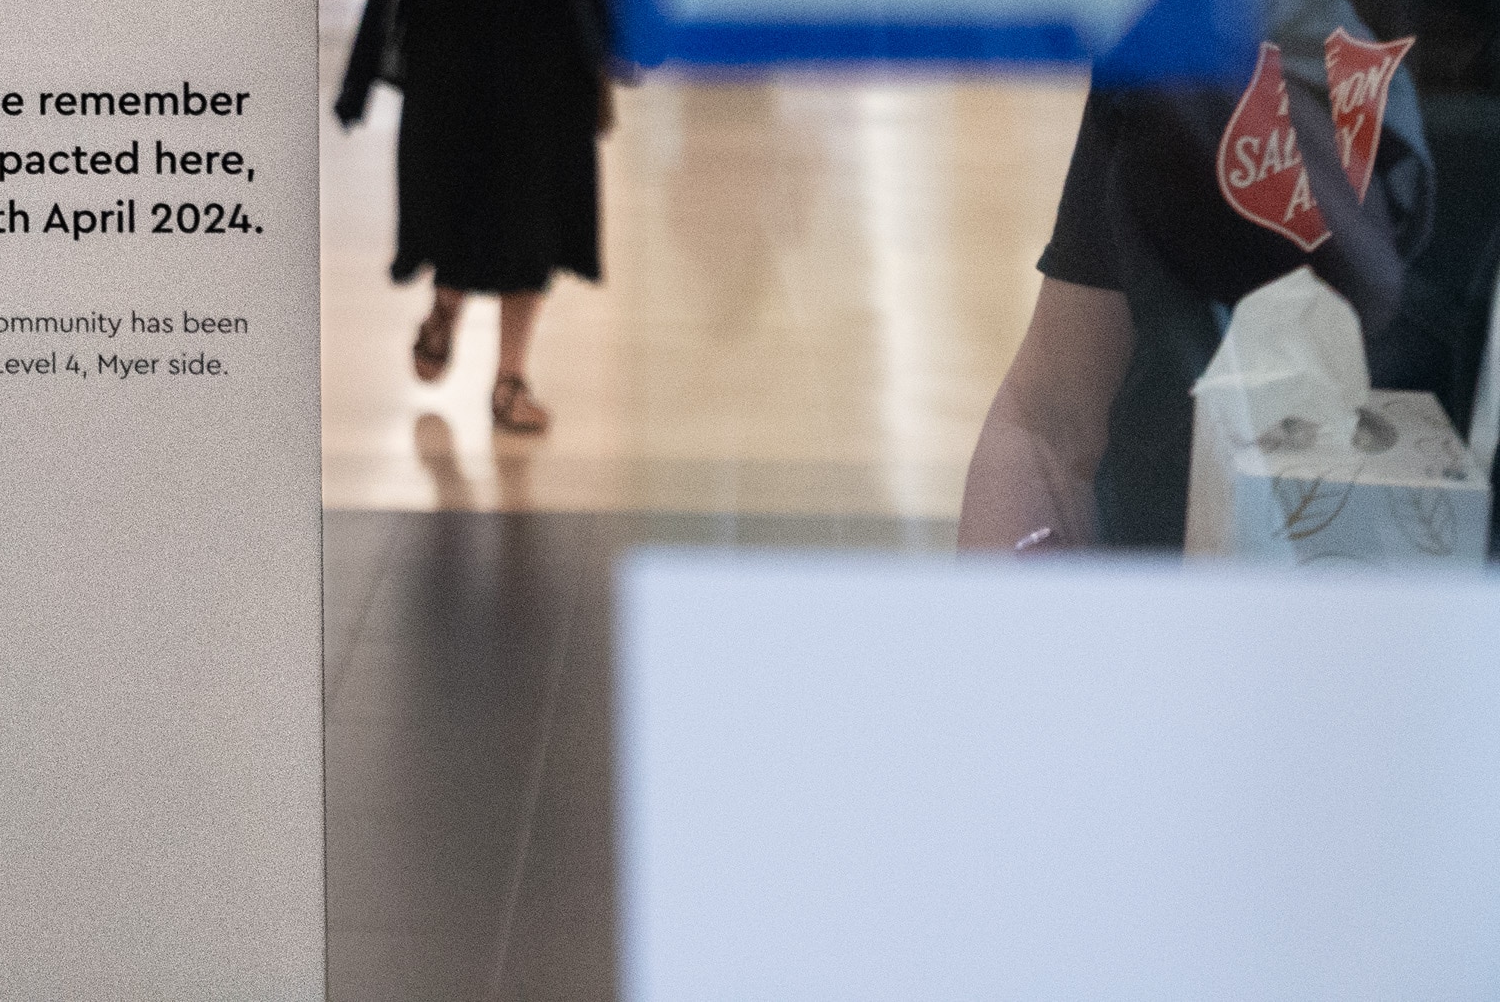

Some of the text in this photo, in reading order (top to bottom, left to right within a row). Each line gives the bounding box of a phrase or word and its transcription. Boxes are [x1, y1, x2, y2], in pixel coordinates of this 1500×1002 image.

[39, 80, 251, 117] remember
[154, 139, 256, 183] here,
[42, 198, 136, 242] April
[150, 201, 264, 235] 2024.
[130, 310, 175, 334] has
[182, 310, 249, 335] been
[64, 354, 89, 381] 4,
[97, 353, 161, 381] Myer
[168, 352, 229, 377] side.
